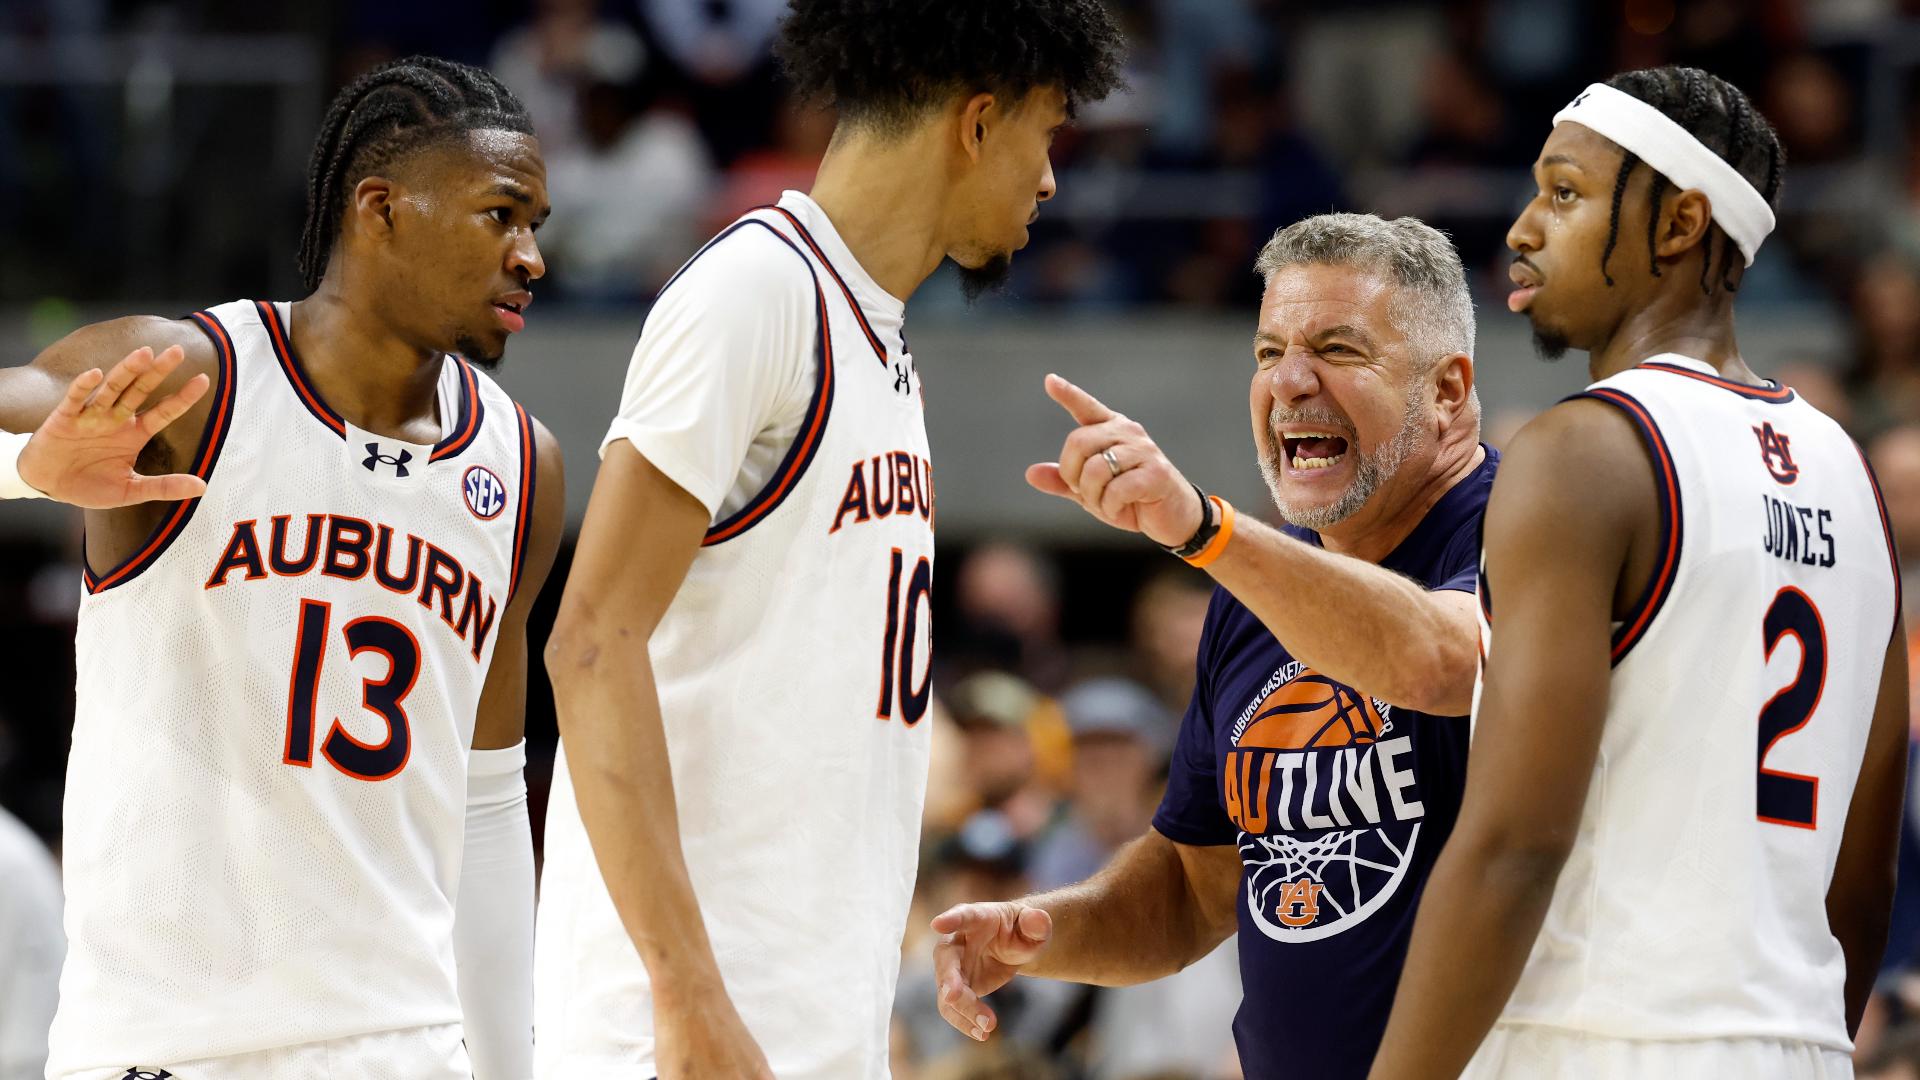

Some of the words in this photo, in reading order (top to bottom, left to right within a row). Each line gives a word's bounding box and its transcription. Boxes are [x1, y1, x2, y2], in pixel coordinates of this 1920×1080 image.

[465, 467, 504, 517] SEC
[828, 450, 935, 534] AUBU
[1763, 494, 1835, 569] JONES
[205, 513, 496, 663] AUBURN
[876, 546, 932, 729] 10
[283, 598, 422, 782] 13
[1230, 694, 1262, 748] AUBURN
[1756, 585, 1828, 830] 2
[1224, 735, 1425, 834] AUTLIVE
